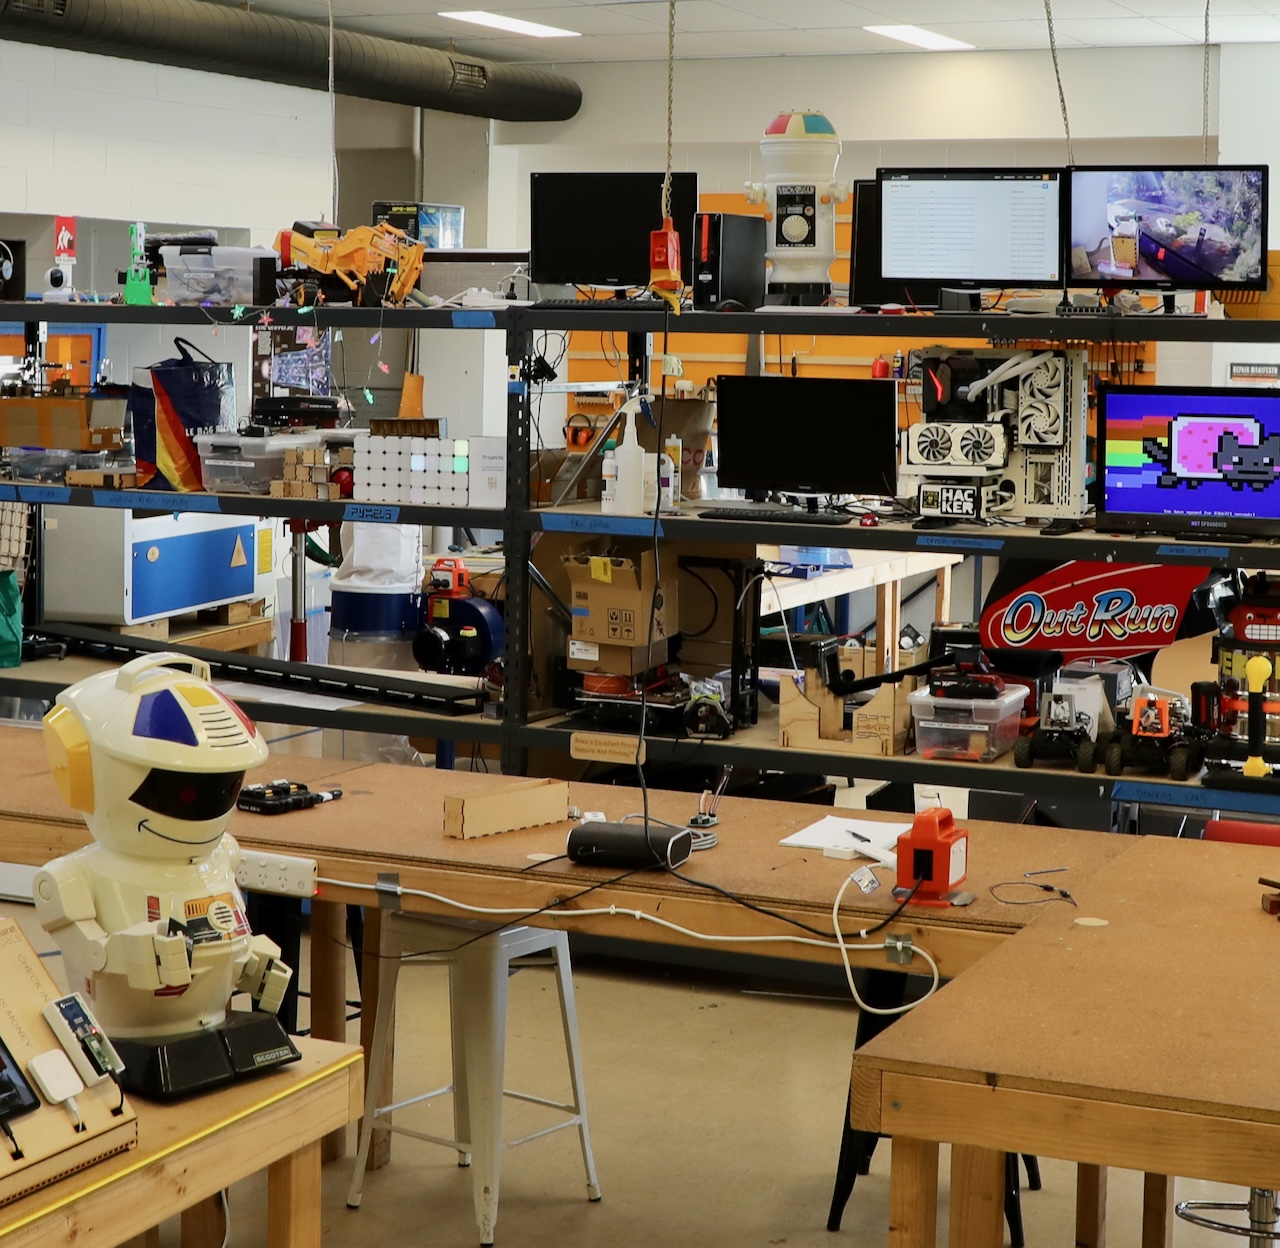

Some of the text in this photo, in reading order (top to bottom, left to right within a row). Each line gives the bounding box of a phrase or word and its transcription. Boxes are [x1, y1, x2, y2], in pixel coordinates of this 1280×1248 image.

[941, 488, 974, 502] HAC
[941, 501, 974, 515] KER
[574, 746, 595, 754] Repairs
[594, 739, 620, 747] Excellent
[17, 953, 51, 1002] CHECK IN
[6, 1010, 33, 1048] MONEY
[255, 1049, 289, 1063] SCOOTER
